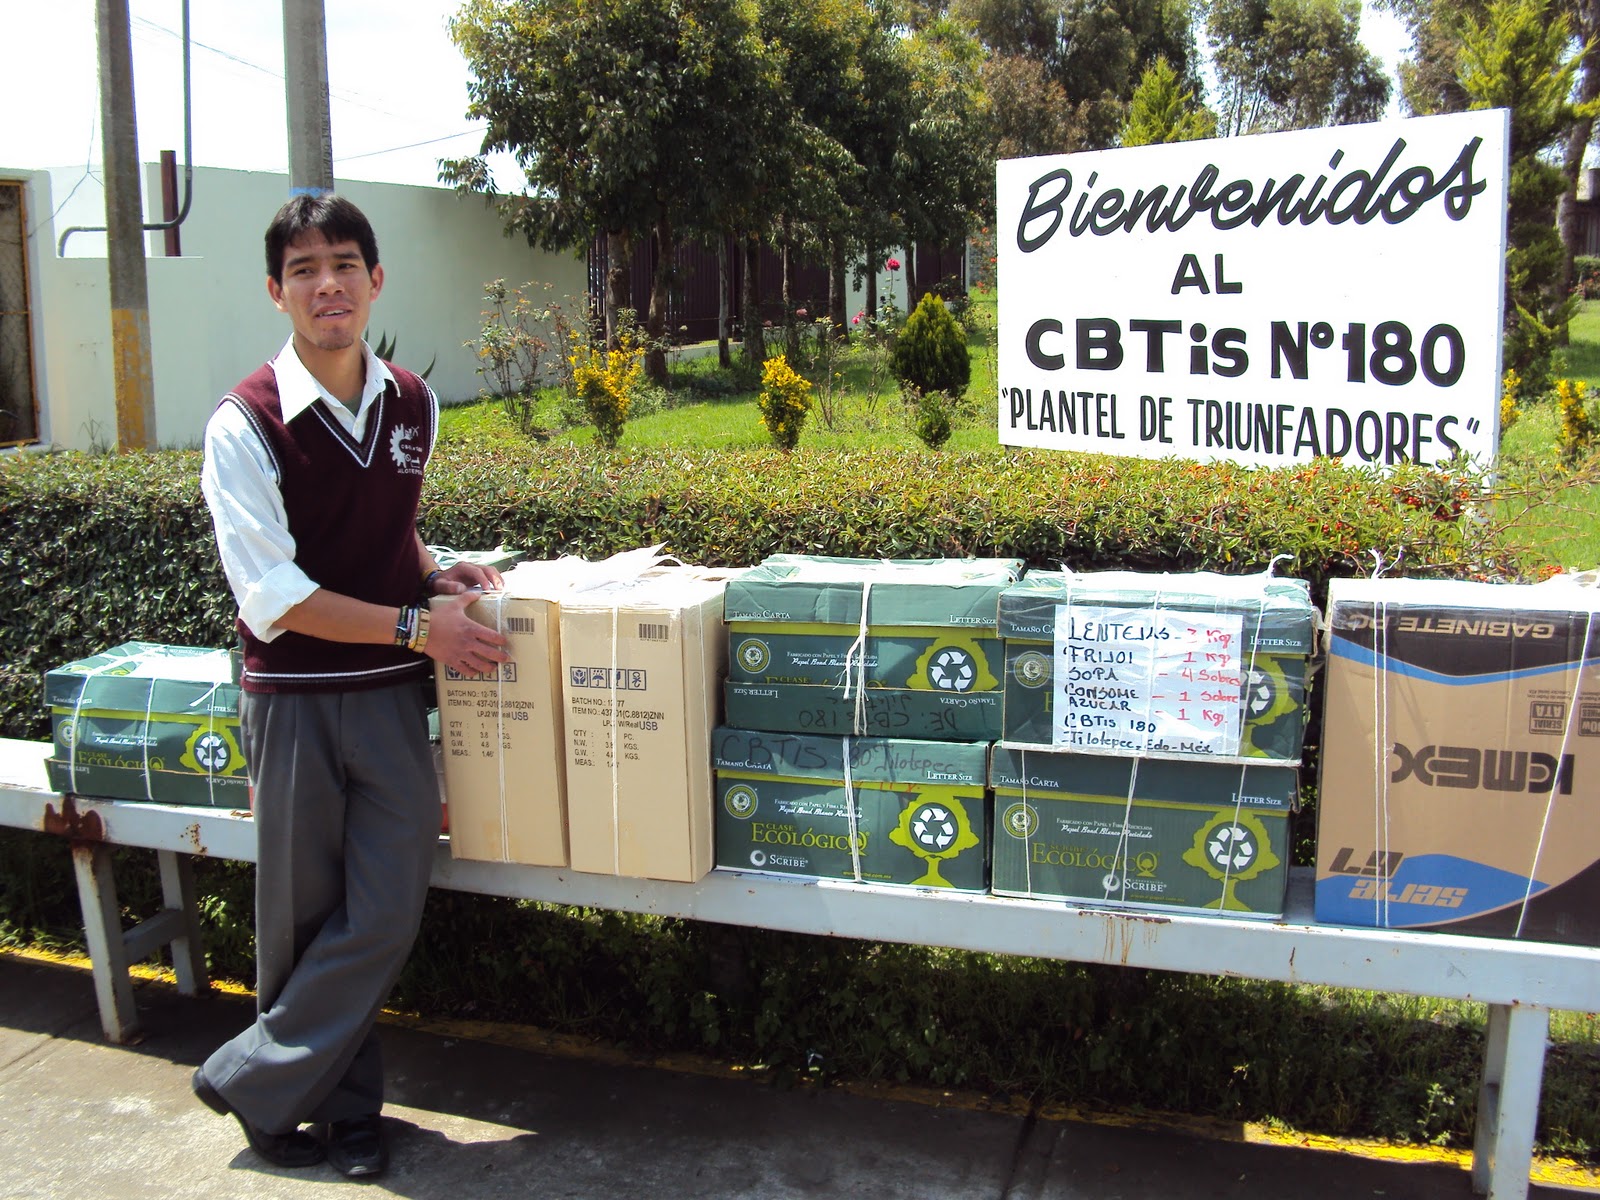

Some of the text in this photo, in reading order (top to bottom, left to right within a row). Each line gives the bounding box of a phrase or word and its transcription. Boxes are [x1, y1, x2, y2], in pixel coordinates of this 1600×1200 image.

[1016, 136, 1488, 253] Bienvenidos
[1170, 253, 1244, 295] AL
[1139, 395, 1173, 444] DE
[762, 609, 791, 619] CARTA
[949, 614, 982, 625] LETTER
[1010, 623, 1041, 633] TAMAÑO
[1068, 617, 1170, 642] LENTEJAS
[1397, 616, 1555, 640] GABINETE
[1249, 634, 1284, 646] LETTER
[1068, 666, 1119, 681] SOPA
[447, 689, 467, 697] BATCH
[749, 688, 778, 699] LETTER
[447, 699, 463, 707] ITEM
[571, 697, 592, 705] BATCH
[939, 696, 968, 708] CARTA
[1069, 695, 1132, 712] AZUCAR
[511, 711, 529, 721] USB
[571, 707, 588, 715] ITEM
[1535, 705, 1563, 718] ATA
[639, 720, 659, 731] USB
[1129, 719, 1157, 733] 180
[1533, 719, 1563, 729] SERIAL
[926, 770, 958, 781] LETTER
[1030, 776, 1060, 788] CARTA
[1231, 792, 1283, 805] LETTER SIZE
[765, 823, 795, 832] CLASE
[1031, 842, 1159, 874] ECOLÓGICO
